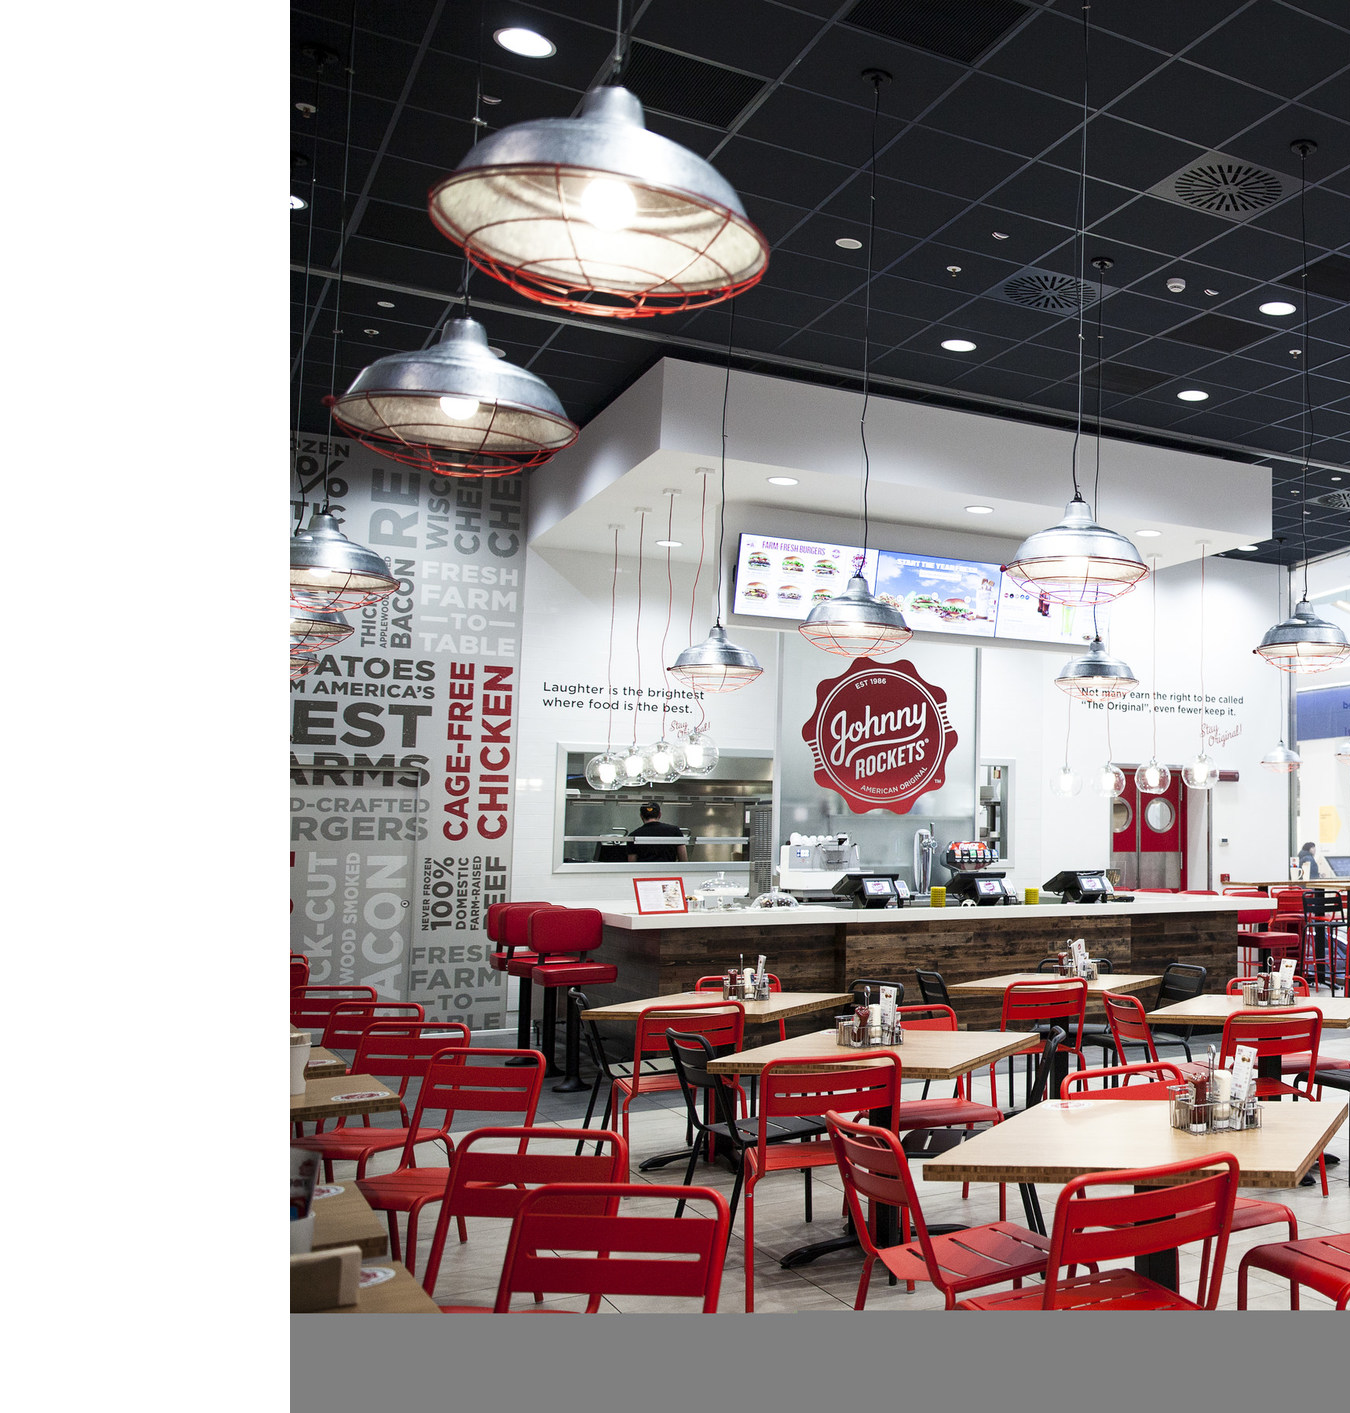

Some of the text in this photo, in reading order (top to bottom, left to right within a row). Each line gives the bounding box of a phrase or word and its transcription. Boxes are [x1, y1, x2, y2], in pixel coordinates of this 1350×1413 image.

[762, 540, 779, 550] FARM
[780, 542, 799, 553] FRESH
[799, 544, 826, 556] BURGERS
[421, 561, 518, 587] FRESH
[390, 558, 415, 649] BACON
[420, 584, 517, 612] FARM
[418, 632, 515, 657] TABLE
[313, 680, 435, 700] AMERICA'S
[543, 681, 705, 701] Laughter is the brightest
[855, 677, 887, 690] EST 1986
[1081, 687, 1244, 704] Not many earn the right to be called
[542, 697, 693, 714] where food is the best.
[1081, 700, 1104, 710] "The
[1154, 705, 1175, 714] even
[1177, 705, 1202, 715] fewer
[1204, 707, 1226, 717] keep
[1228, 708, 1236, 716] it.
[830, 701, 927, 766] Johnny
[1201, 722, 1219, 738] Stay
[1208, 724, 1243, 748] Original!
[443, 661, 475, 842] CAGE-FREE
[476, 665, 514, 840] CHICKEN
[860, 766, 928, 795] AMERICAN ORIGINAL
[342, 852, 361, 925] SMOKED
[421, 857, 432, 931] NEVER FROZEN
[430, 856, 455, 931] 100%
[455, 856, 469, 930] DOMESTIC
[470, 855, 482, 931] FARM-RAISED
[483, 856, 507, 929] EEF
[360, 855, 408, 1016] ACON
[410, 967, 502, 991] FARM
